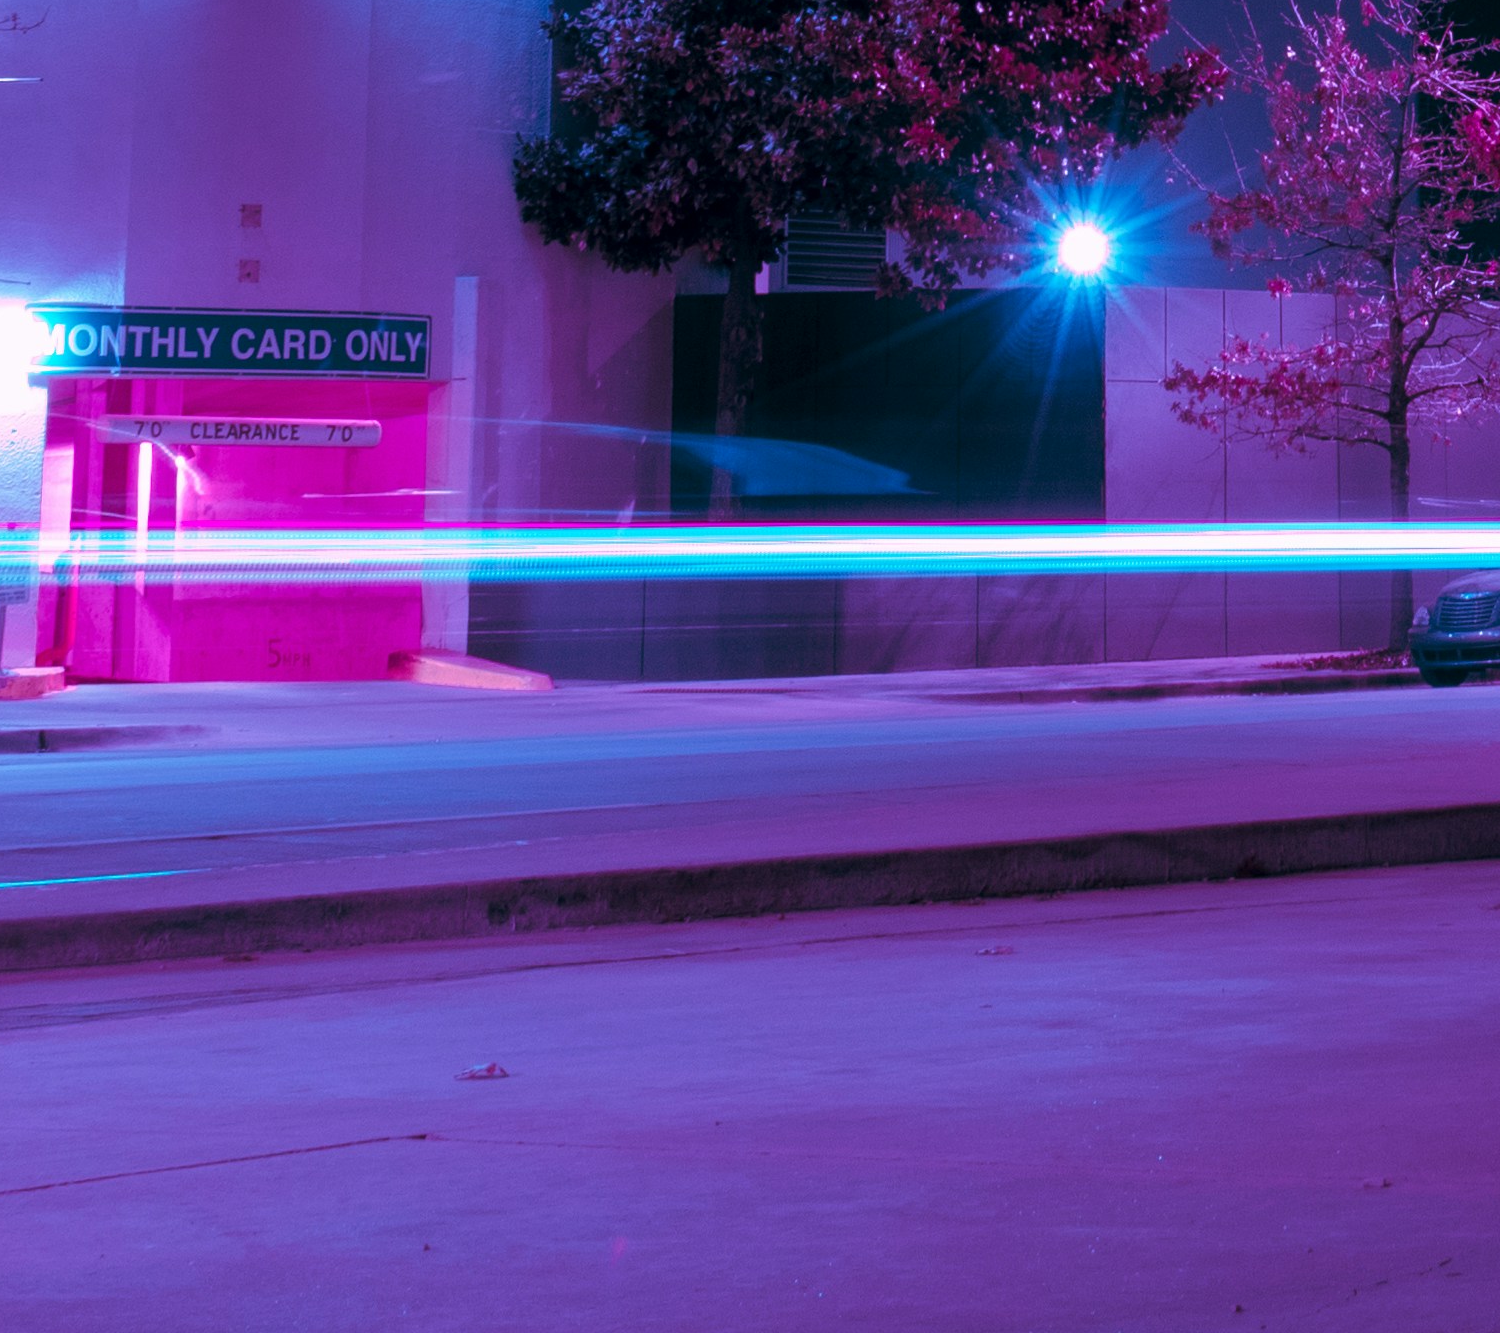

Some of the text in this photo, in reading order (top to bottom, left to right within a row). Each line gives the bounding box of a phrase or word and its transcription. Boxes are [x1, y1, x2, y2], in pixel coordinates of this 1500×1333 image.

[44, 321, 426, 363] MONTHLY CARD ONLY
[189, 420, 301, 442] CLEARANCE
